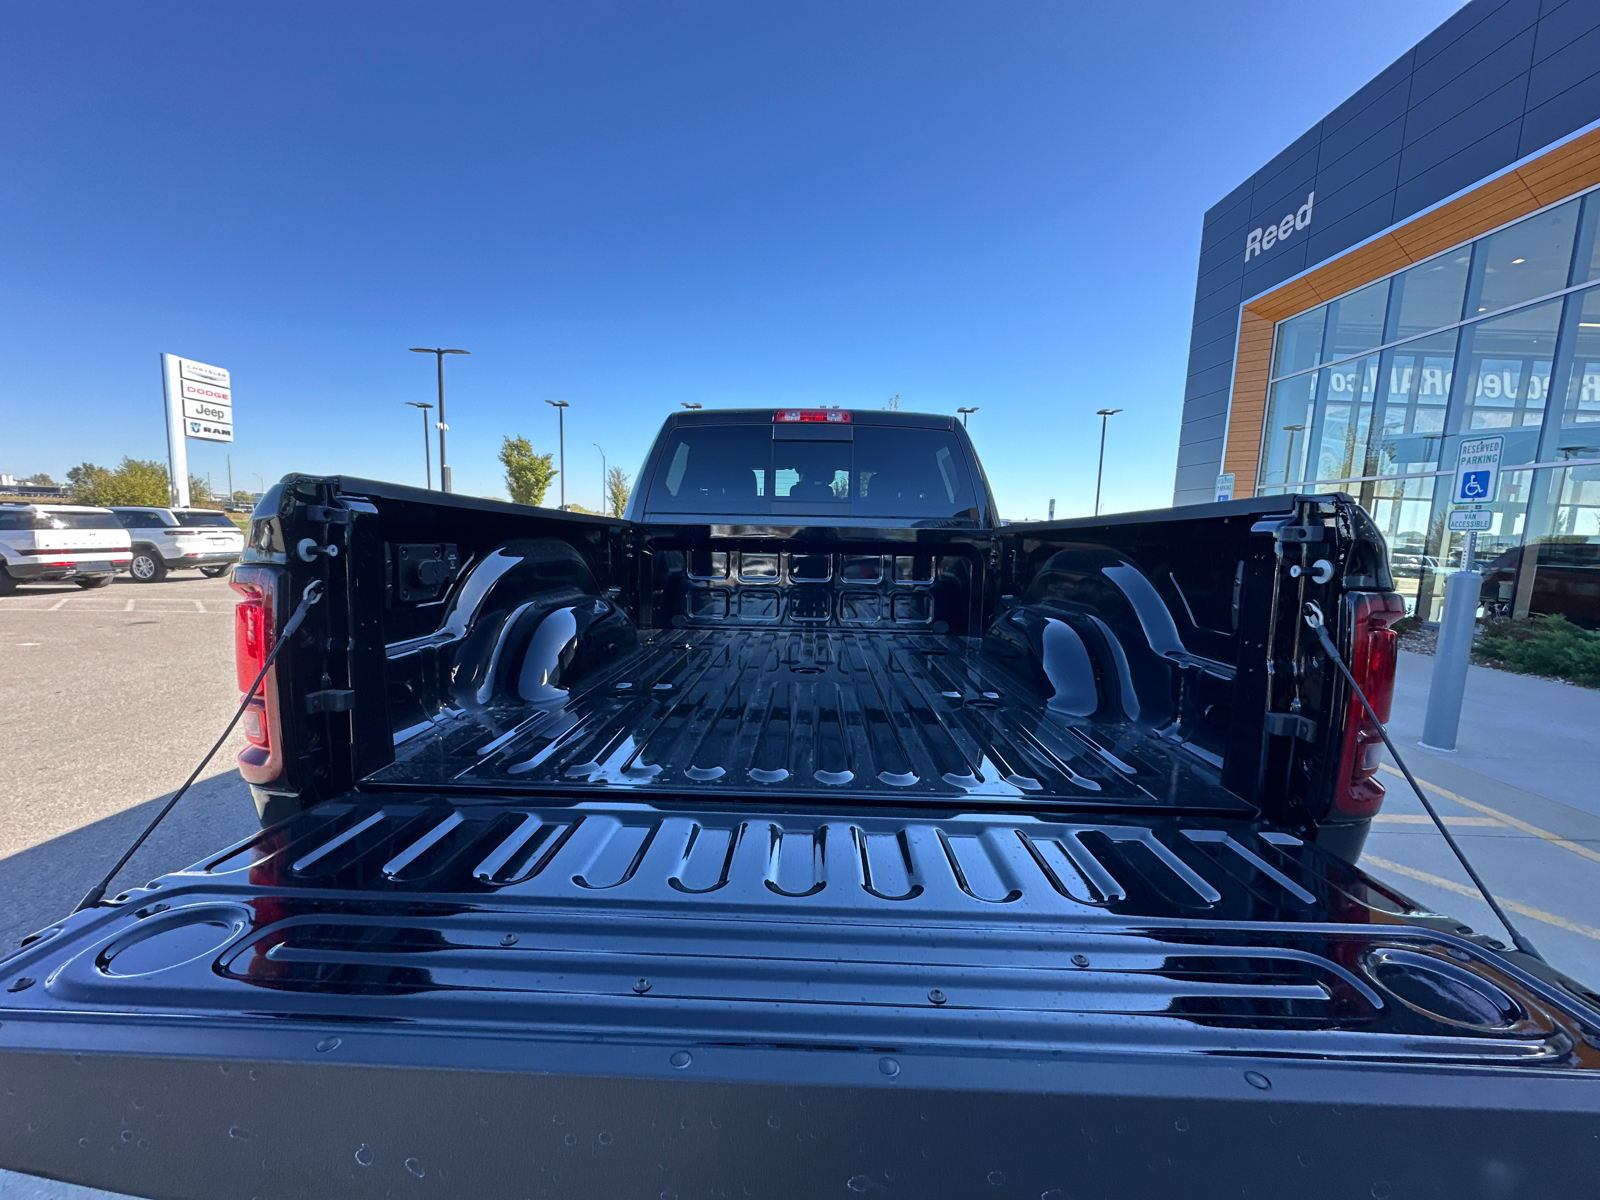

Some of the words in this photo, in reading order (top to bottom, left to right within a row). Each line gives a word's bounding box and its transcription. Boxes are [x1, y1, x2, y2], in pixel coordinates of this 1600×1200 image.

[1244, 191, 1315, 263] Reed
[187, 364, 227, 378] CHRYSLER
[187, 386, 229, 401] DODGE
[195, 404, 225, 420] Jeep
[203, 426, 231, 436] RAM
[1462, 441, 1500, 455] RESERVED
[1460, 454, 1498, 466] PARKING
[1450, 520, 1489, 528] ACCESSIBLE
